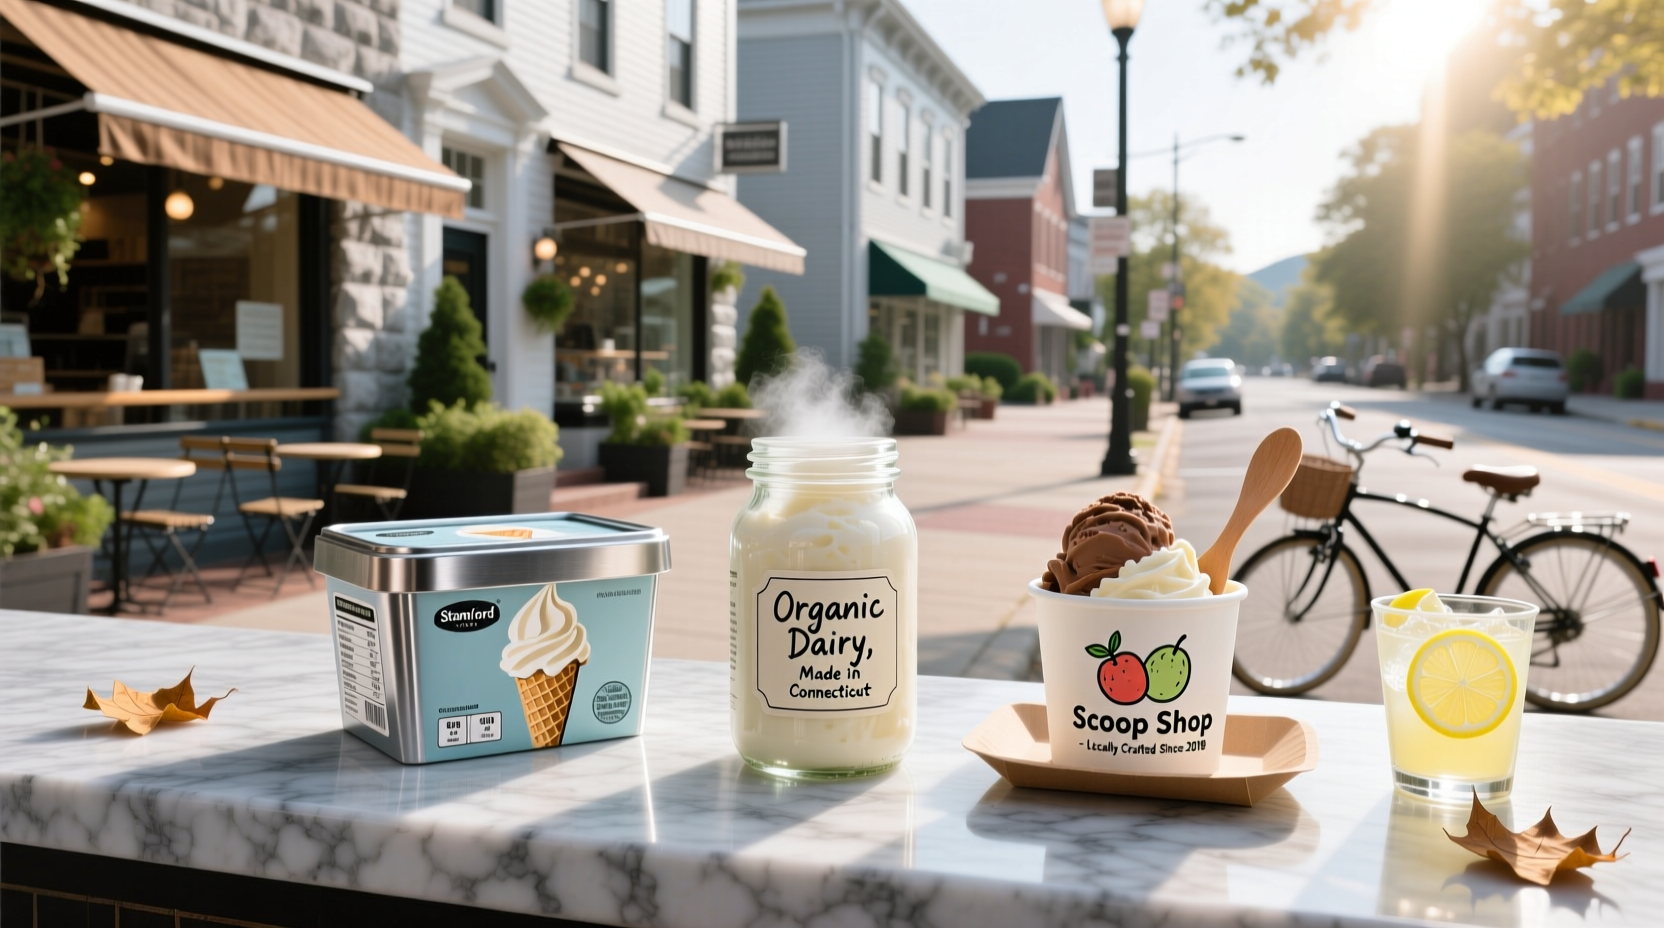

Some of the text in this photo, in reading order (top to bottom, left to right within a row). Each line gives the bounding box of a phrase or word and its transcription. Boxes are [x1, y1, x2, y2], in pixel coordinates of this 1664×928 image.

[440, 605, 495, 623] Stamford
[773, 590, 885, 634] Organic
[787, 626, 873, 667] Dairy,
[799, 665, 861, 680] Made in
[789, 682, 872, 699] Connecticut
[1072, 705, 1213, 740] Scoop Shop
[1159, 743, 1184, 754] Since
